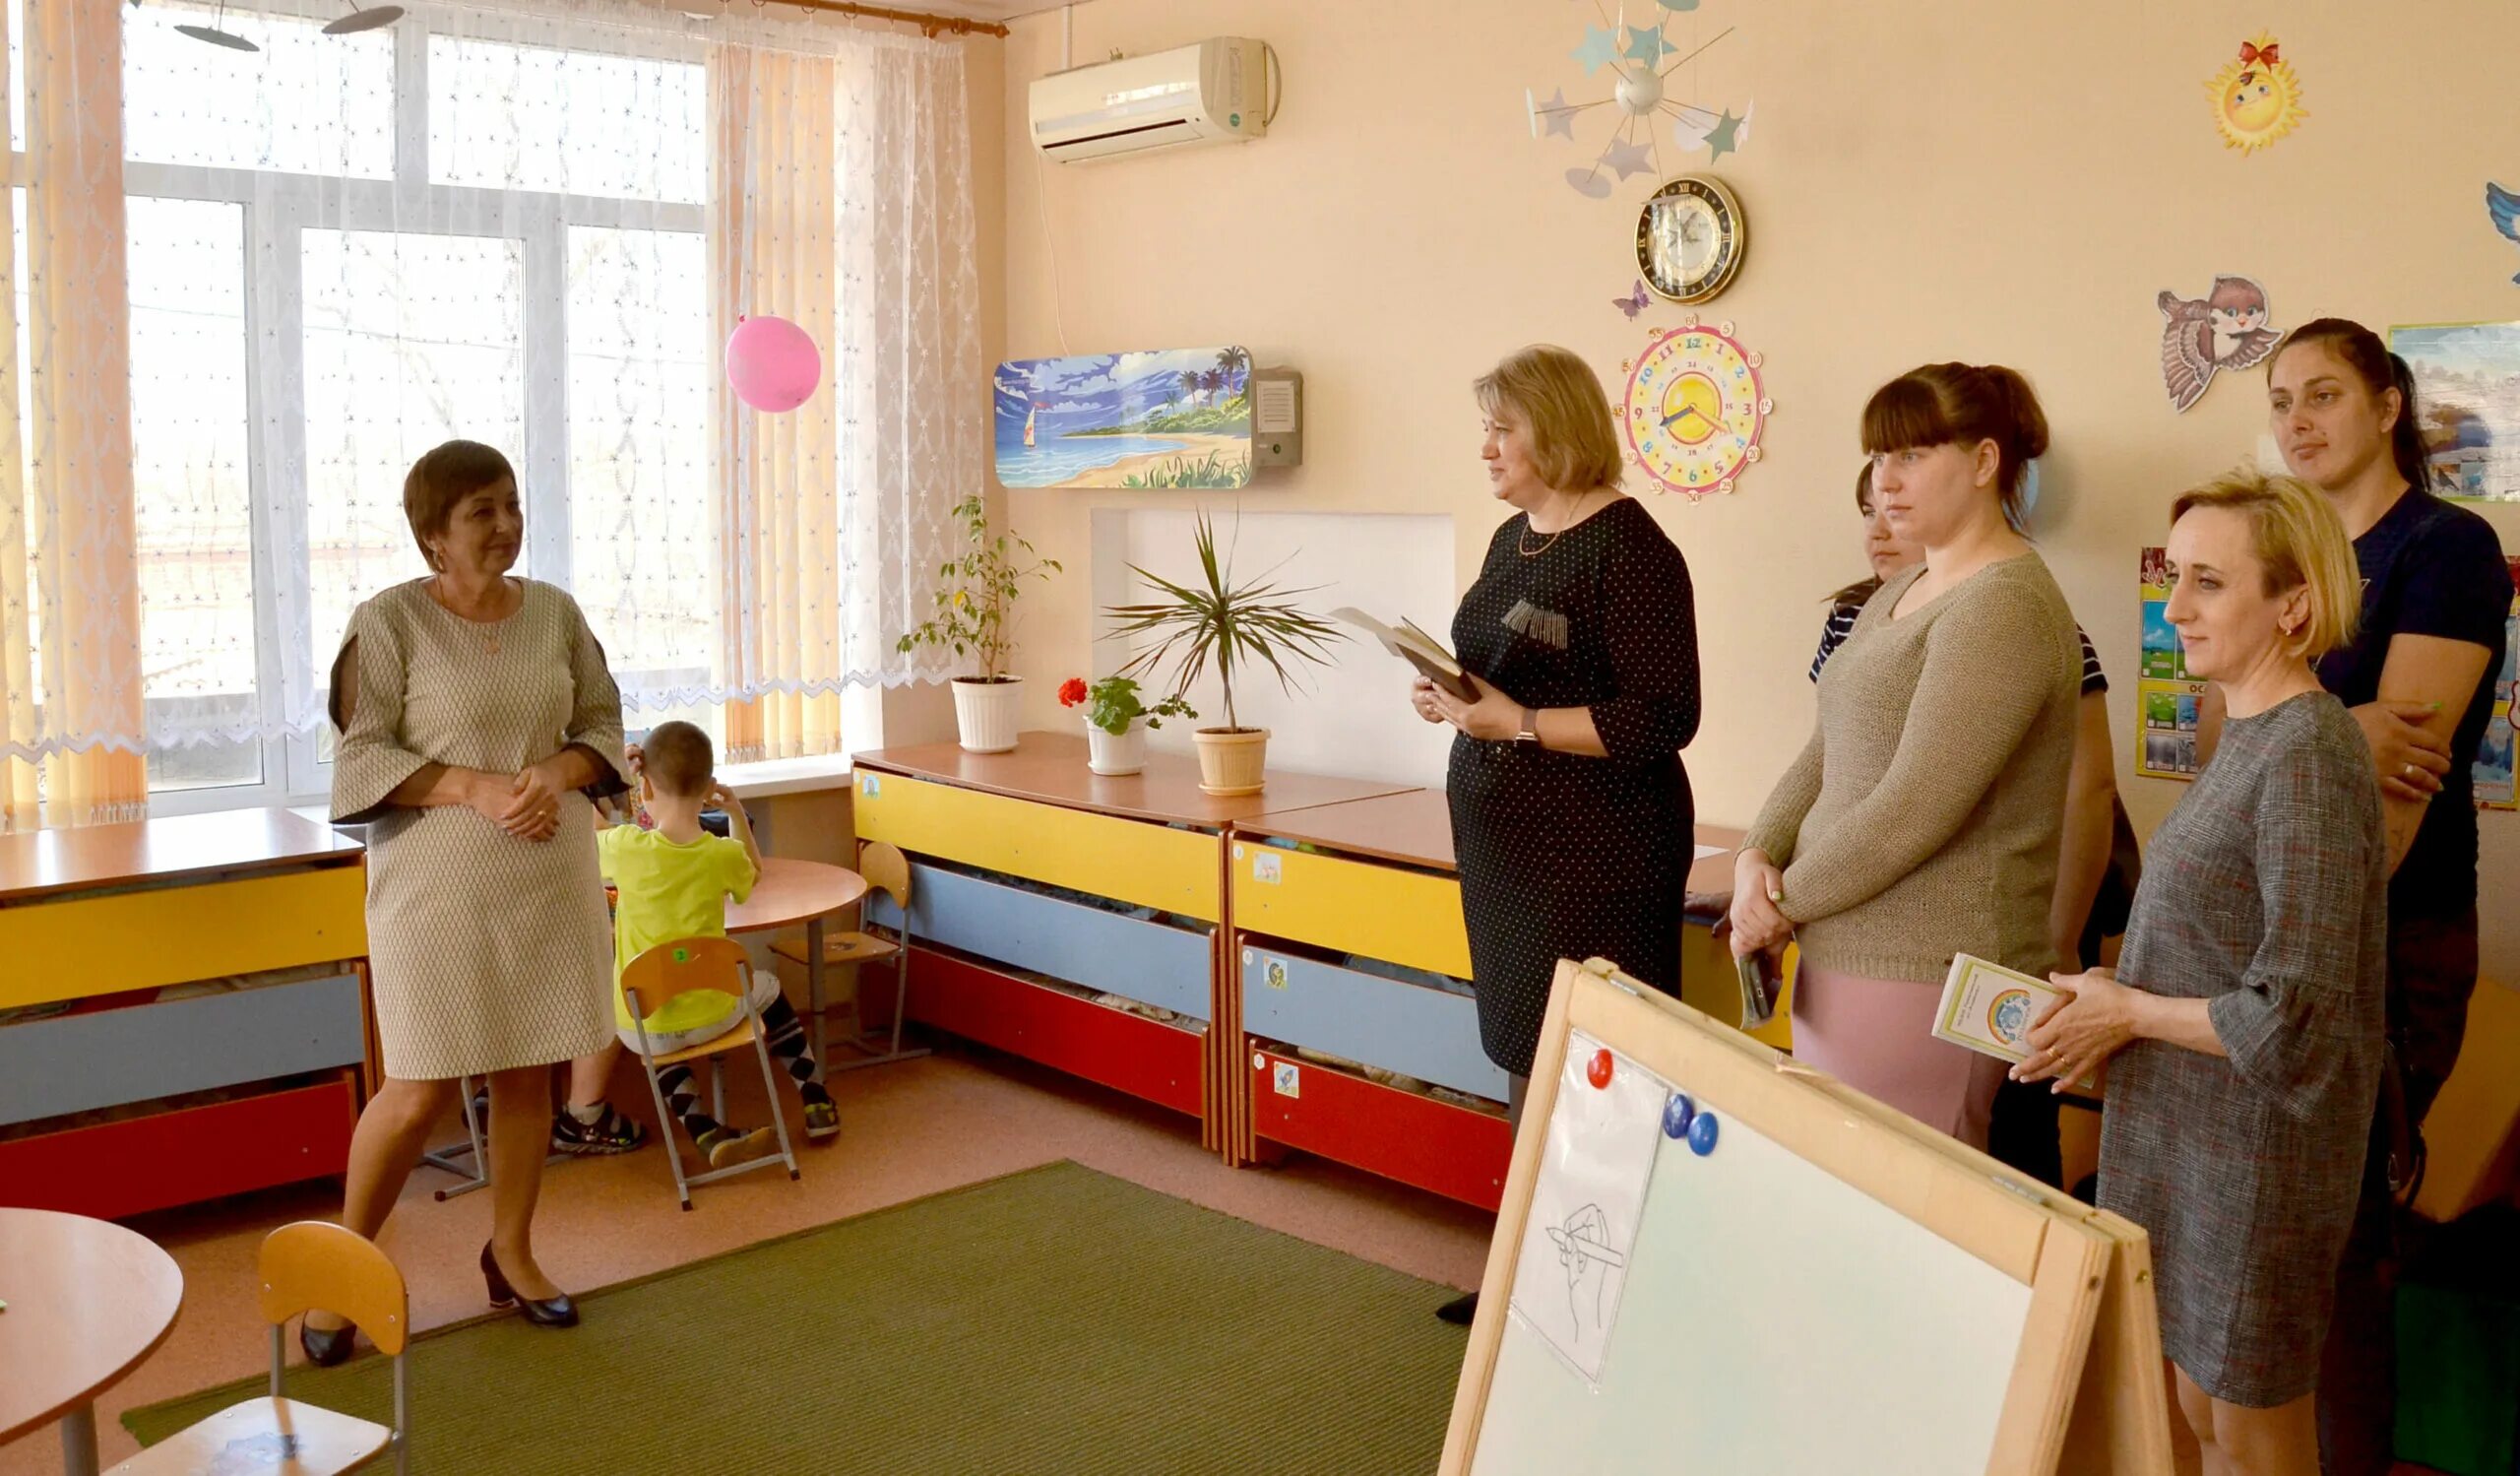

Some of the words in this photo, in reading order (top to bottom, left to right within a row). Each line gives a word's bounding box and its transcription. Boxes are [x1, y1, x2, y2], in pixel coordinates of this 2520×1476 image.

[1678, 183, 1690, 193] XII
[1638, 238, 1646, 248] IX
[1723, 325, 1730, 334] 5
[1686, 338, 1701, 349] 12
[1716, 344, 1724, 354] 1
[1659, 345, 1672, 361] 11
[1749, 356, 1760, 365] 10
[1640, 367, 1653, 385] 10
[1734, 366, 1744, 378] 2
[1635, 408, 1643, 419] 9
[1743, 403, 1751, 416] 3
[1643, 441, 1653, 453] 8
[1735, 437, 1745, 448] 4
[1663, 461, 1671, 475] 7
[1715, 460, 1724, 474] 5
[1689, 470, 1697, 481] 6
[1722, 481, 1732, 490] 25
